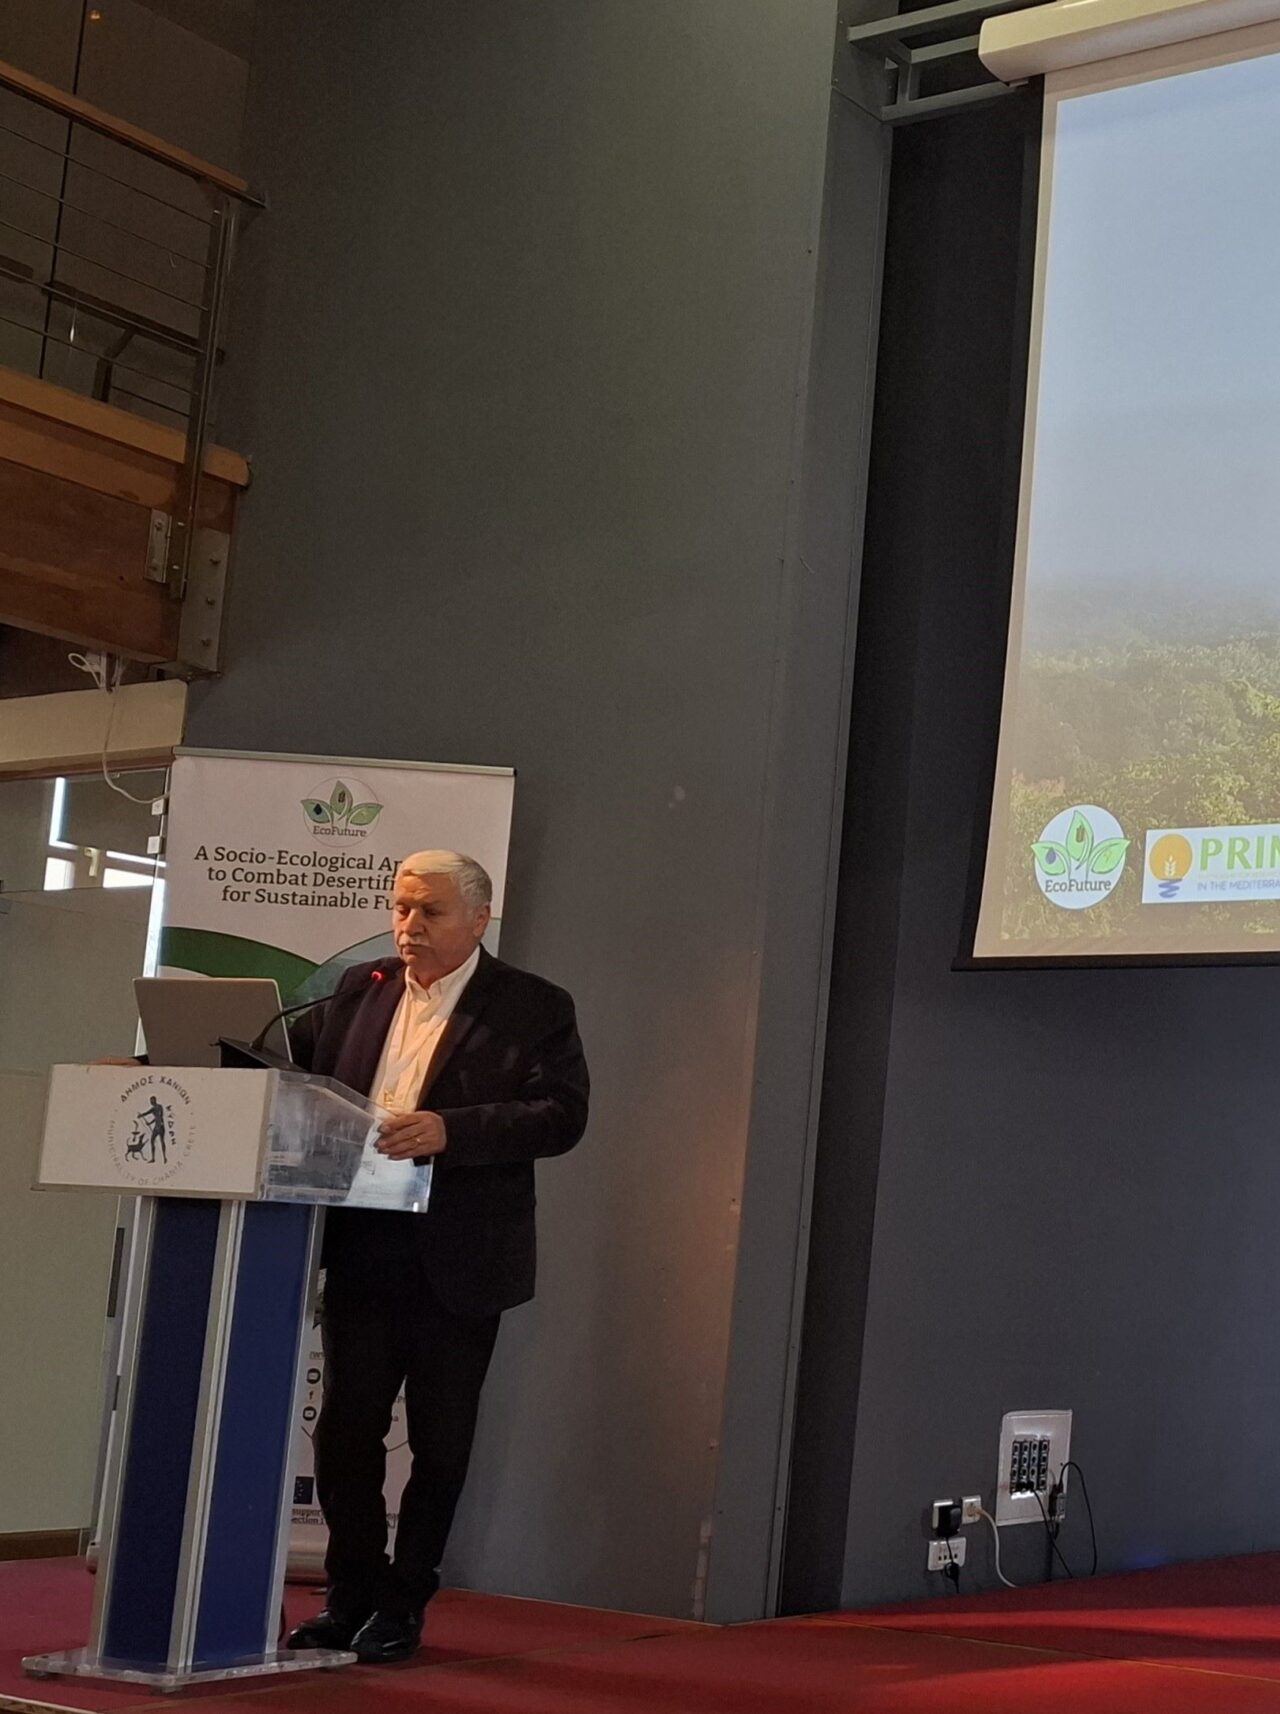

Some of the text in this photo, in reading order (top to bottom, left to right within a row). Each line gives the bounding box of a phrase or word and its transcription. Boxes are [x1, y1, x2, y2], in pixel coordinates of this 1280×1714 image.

[312, 825, 368, 838] EcoFuture
[194, 845, 209, 861] A
[213, 846, 374, 872] Socio-Ecological
[207, 866, 227, 881] to
[231, 867, 308, 887] Combat
[1044, 878, 1112, 893] EcoFuture
[1210, 880, 1226, 891] THE
[221, 885, 251, 902] for
[254, 888, 369, 909] Sustainable
